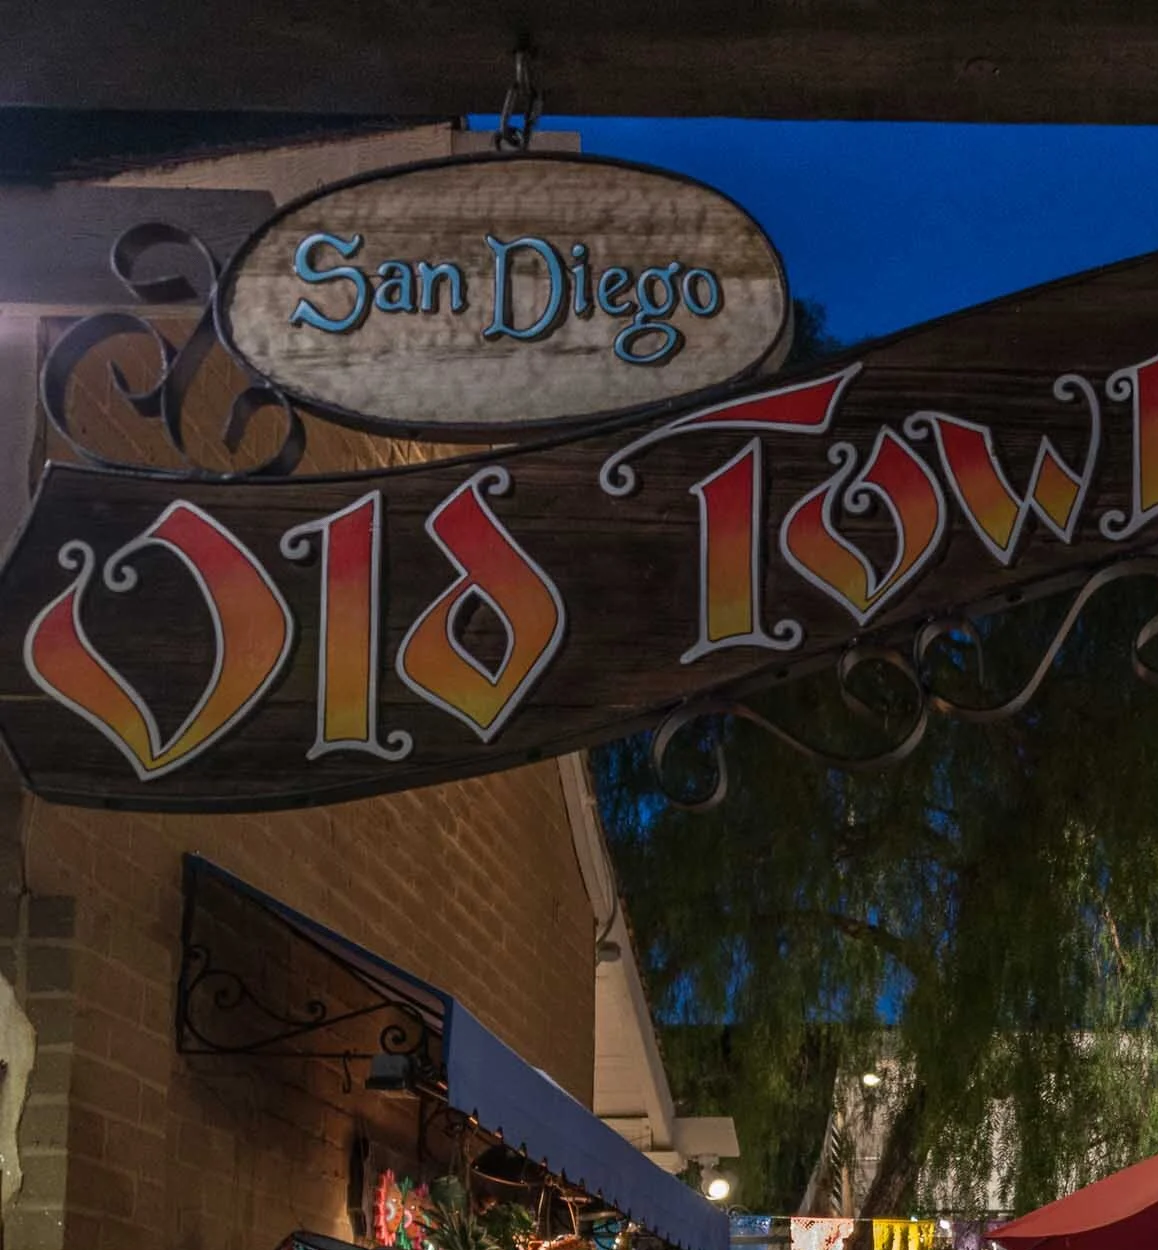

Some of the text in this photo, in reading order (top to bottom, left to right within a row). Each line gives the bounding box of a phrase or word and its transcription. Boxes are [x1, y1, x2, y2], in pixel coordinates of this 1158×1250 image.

[290, 232, 724, 365] San Diego
[23, 465, 568, 782] Old
